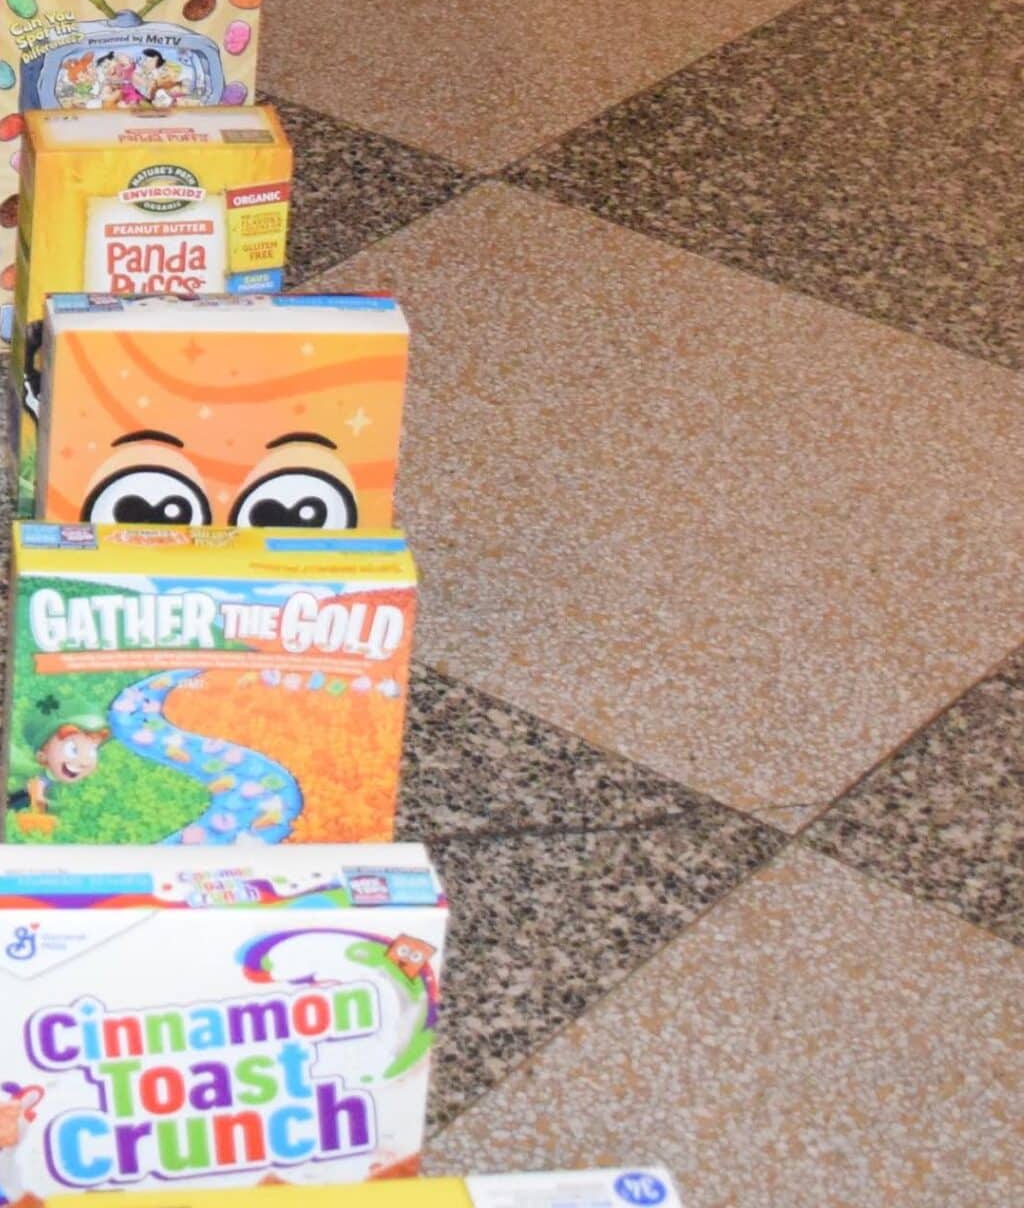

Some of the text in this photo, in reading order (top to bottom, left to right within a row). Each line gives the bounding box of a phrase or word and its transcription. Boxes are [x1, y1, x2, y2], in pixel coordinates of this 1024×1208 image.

[9, 10, 76, 36] Can You
[16, 28, 49, 50] Spot
[122, 187, 203, 201] ENVIROKIDZ
[232, 190, 281, 206] ORGANIC
[113, 223, 208, 235] PEANUT BUTTER
[107, 241, 206, 274] Panda
[29, 589, 405, 660] GATHER THE GOLD
[37, 987, 375, 1063] Cinnamon
[100, 1042, 314, 1118] Toast
[56, 1082, 371, 1182] Crunch
